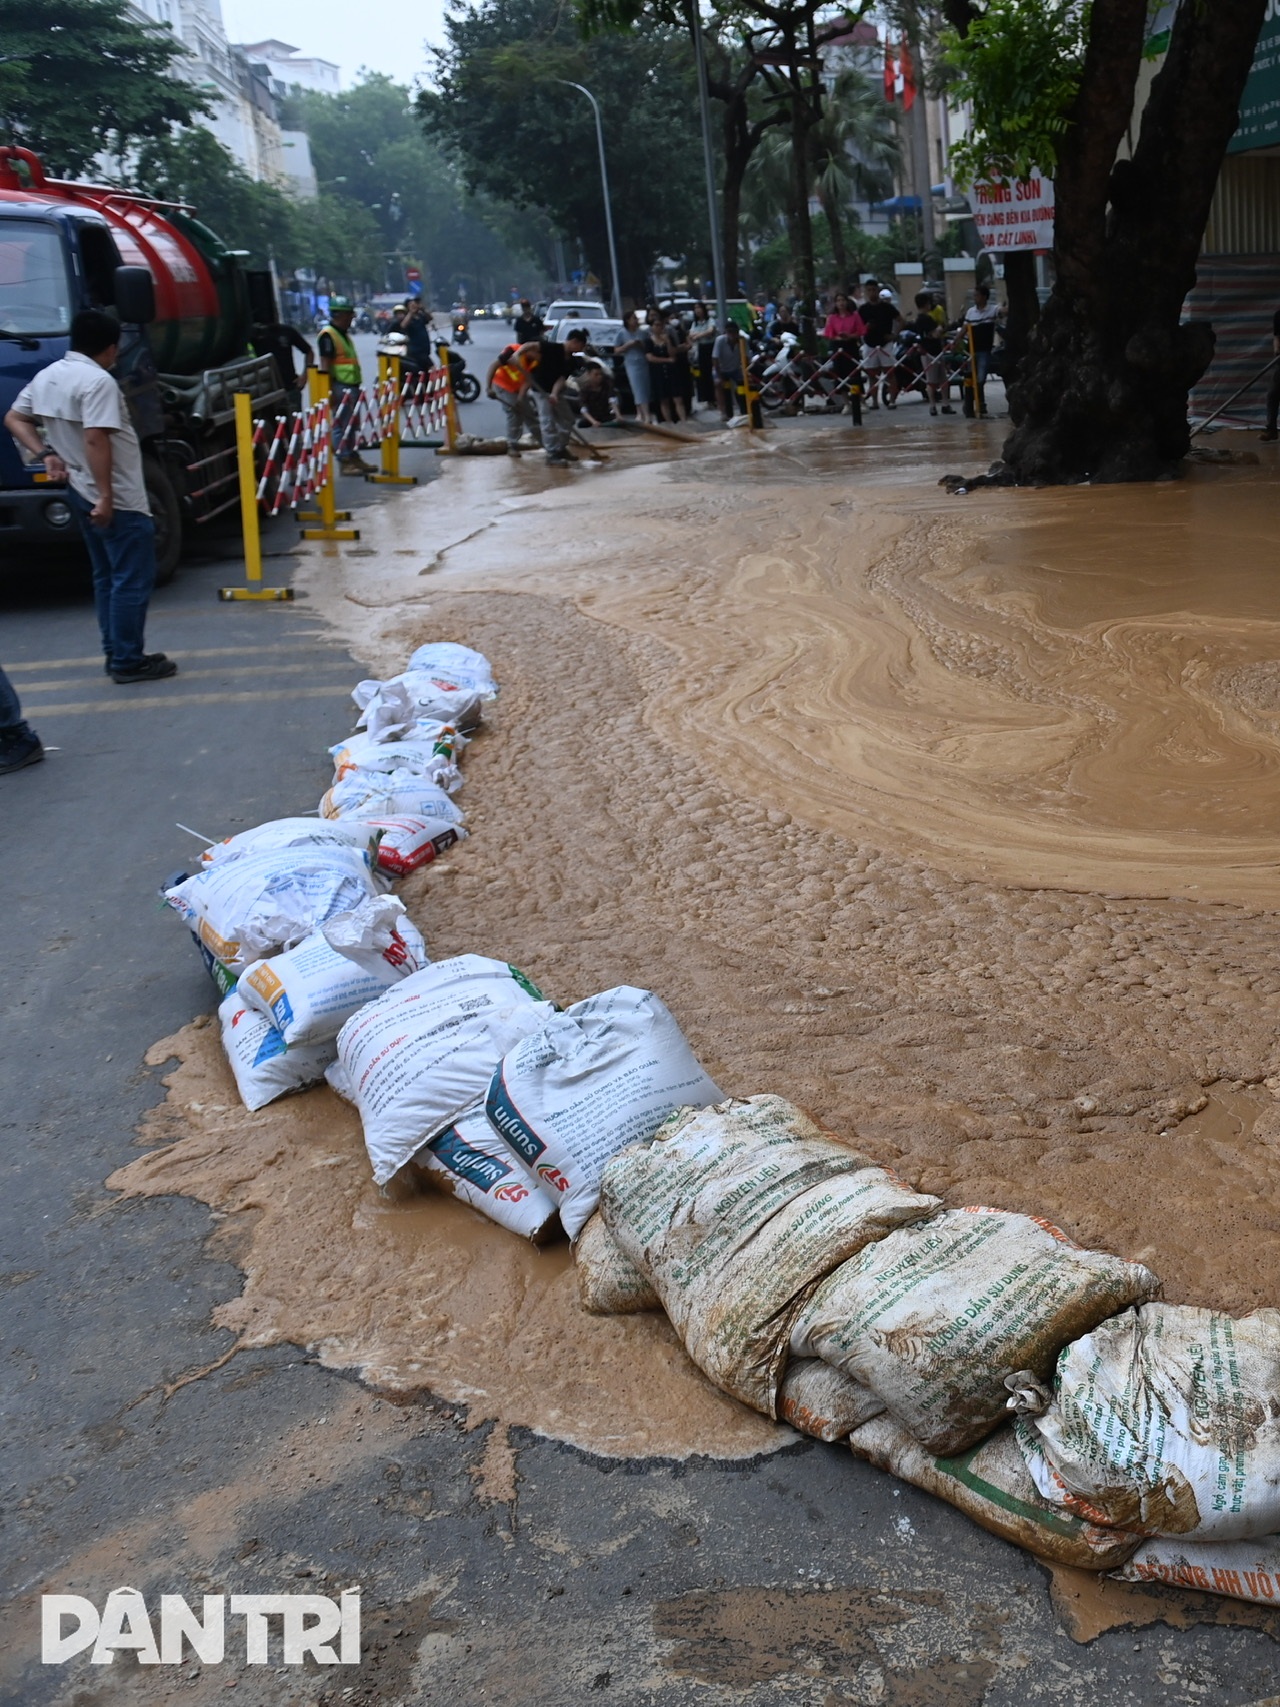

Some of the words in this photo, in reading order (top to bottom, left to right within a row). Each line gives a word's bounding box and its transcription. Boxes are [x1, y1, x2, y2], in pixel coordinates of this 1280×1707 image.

[710, 1174, 758, 1217] NGUYÊN
[753, 1158, 783, 1185] LIỆU
[873, 1250, 923, 1285] NGUYÊN
[917, 1231, 945, 1256] LIỆU
[960, 1290, 992, 1320] DẪN
[984, 1279, 1007, 1300] SỬ
[1098, 1438, 1110, 1465] Canxi
[1116, 1428, 1128, 1447] pho
[1216, 1473, 1226, 1490] cám
[1229, 1494, 1243, 1513] thực
[1240, 1560, 1278, 1598] VỖ
